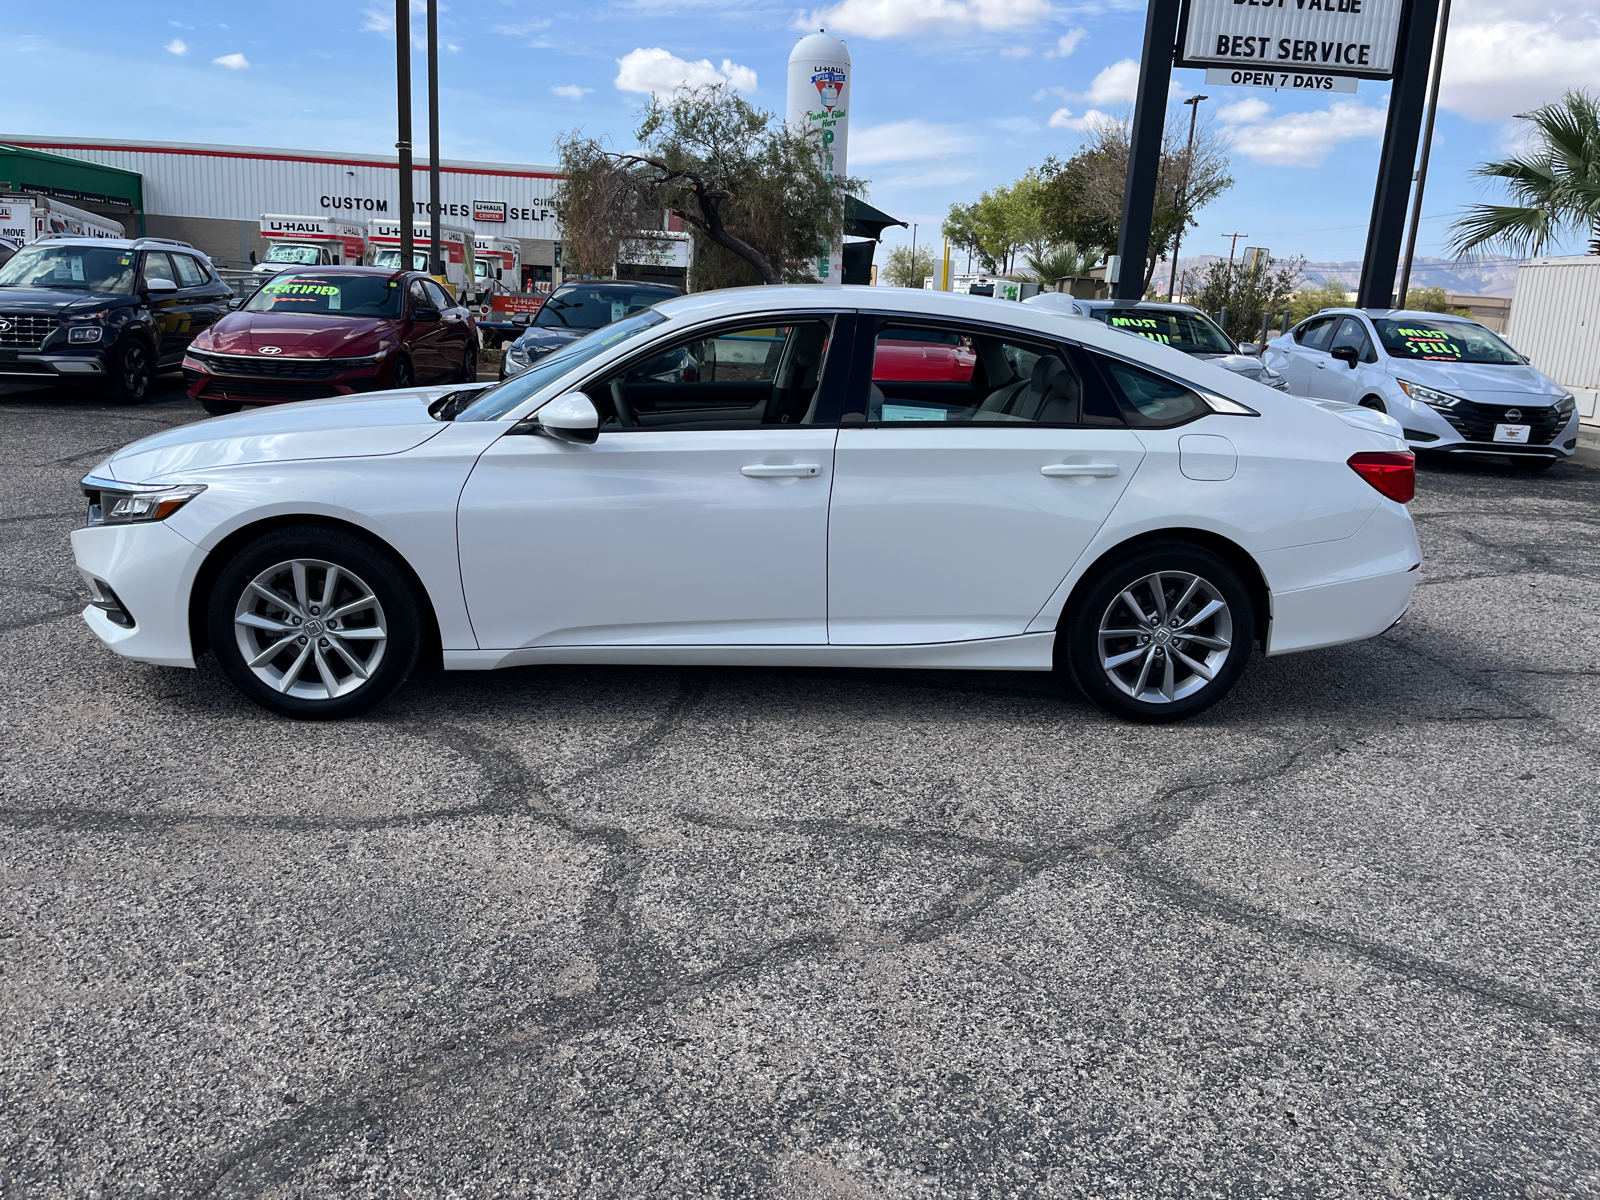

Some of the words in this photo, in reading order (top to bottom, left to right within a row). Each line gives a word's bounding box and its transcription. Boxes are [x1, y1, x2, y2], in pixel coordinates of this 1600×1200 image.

[1216, 34, 1270, 58] BEST
[1278, 38, 1370, 65] SERVICE
[814, 66, 845, 74] U-HAUL
[1231, 71, 1274, 86] OPEN
[1280, 73, 1288, 87] 7
[1293, 75, 1333, 90] DAYS
[809, 110, 829, 121] Tanks
[831, 109, 846, 119] Filled
[822, 119, 837, 128] Here
[320, 195, 388, 212] CUSTOM
[412, 201, 470, 217] ITCHES
[476, 204, 503, 212] U-HAUL
[3, 228, 26, 237] MOVE
[270, 221, 324, 233] U-HAUL
[378, 226, 431, 238] U-HUL
[262, 284, 340, 296] CERTIFIED
[1112, 317, 1157, 329] MUST
[1397, 327, 1449, 340] MUST
[1404, 341, 1462, 357] SELL!
